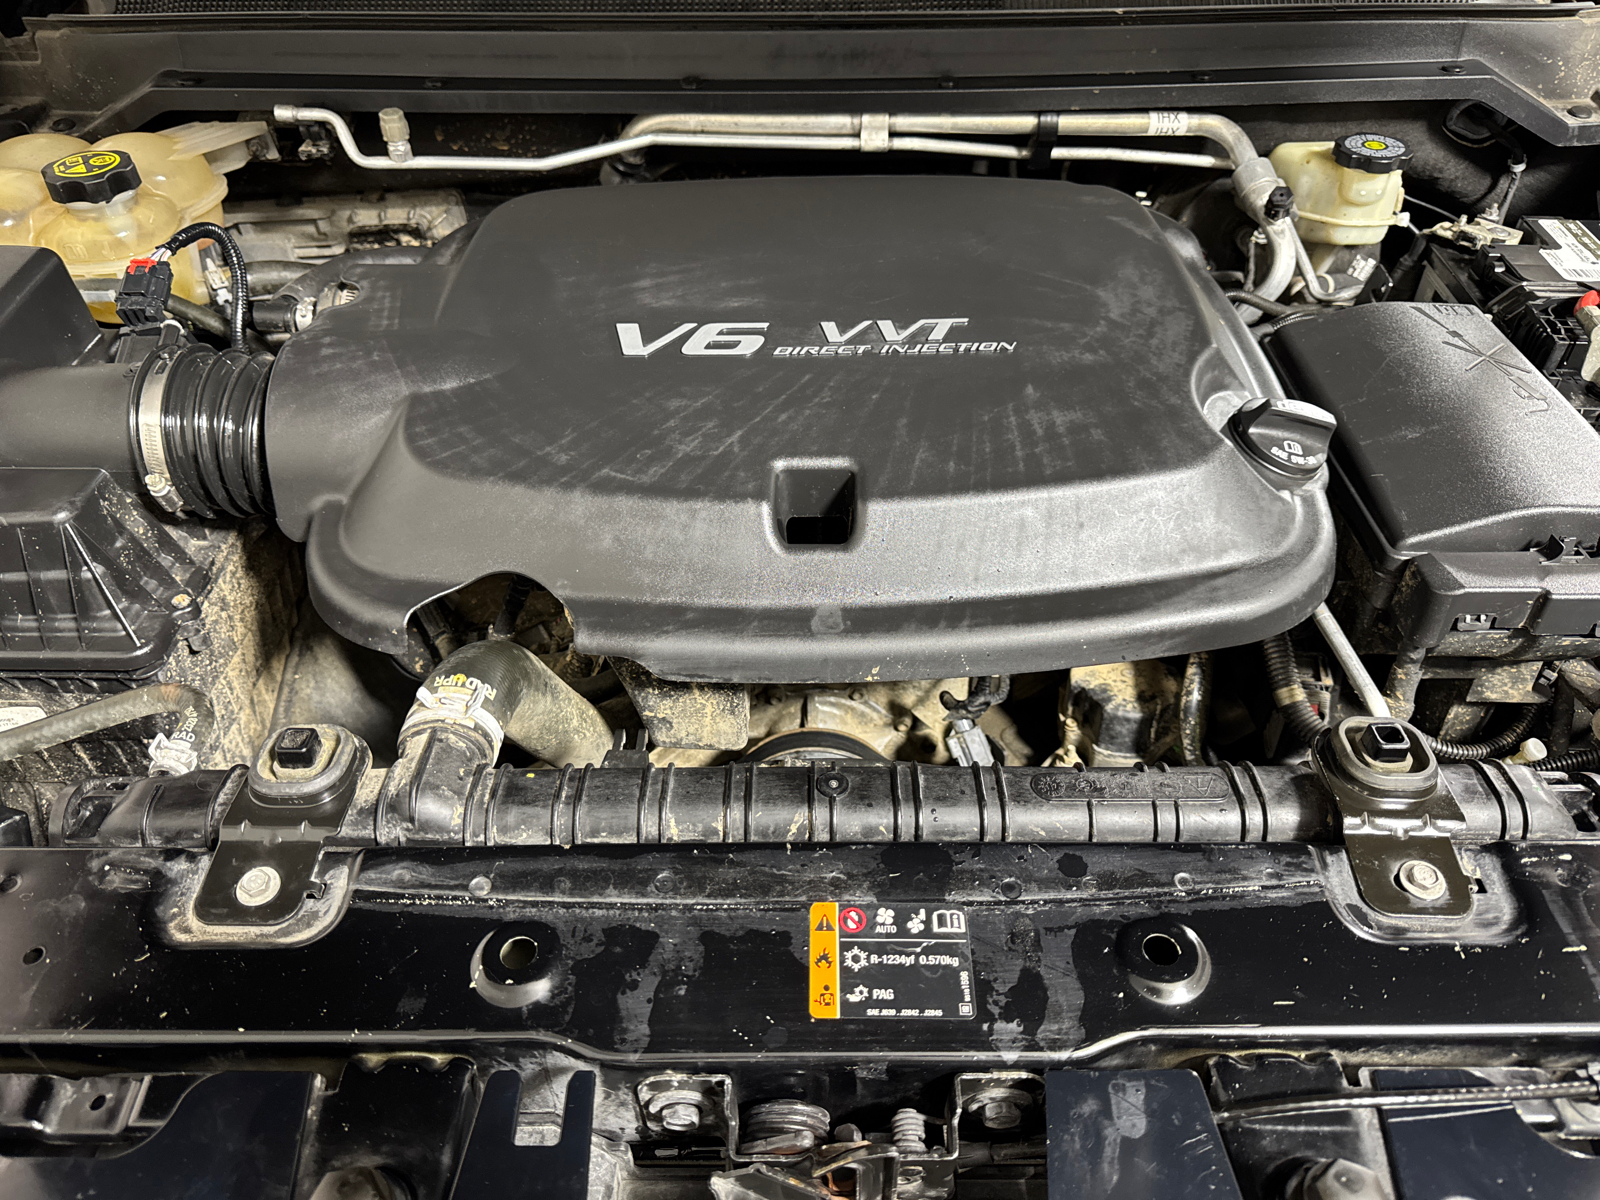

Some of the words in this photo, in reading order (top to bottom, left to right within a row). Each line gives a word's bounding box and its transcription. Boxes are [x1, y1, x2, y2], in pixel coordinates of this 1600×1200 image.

[615, 322, 770, 358] V6
[819, 317, 969, 344] VVT
[773, 343, 870, 357] DIRECT
[878, 341, 1017, 356] INJECTION
[1270, 446, 1289, 460] SAE
[171, 731, 195, 742] RAD
[875, 925, 897, 933] AUTO
[870, 954, 915, 967] R-1234yf
[919, 954, 960, 967] 0.570kg
[872, 989, 895, 1000] PAG
